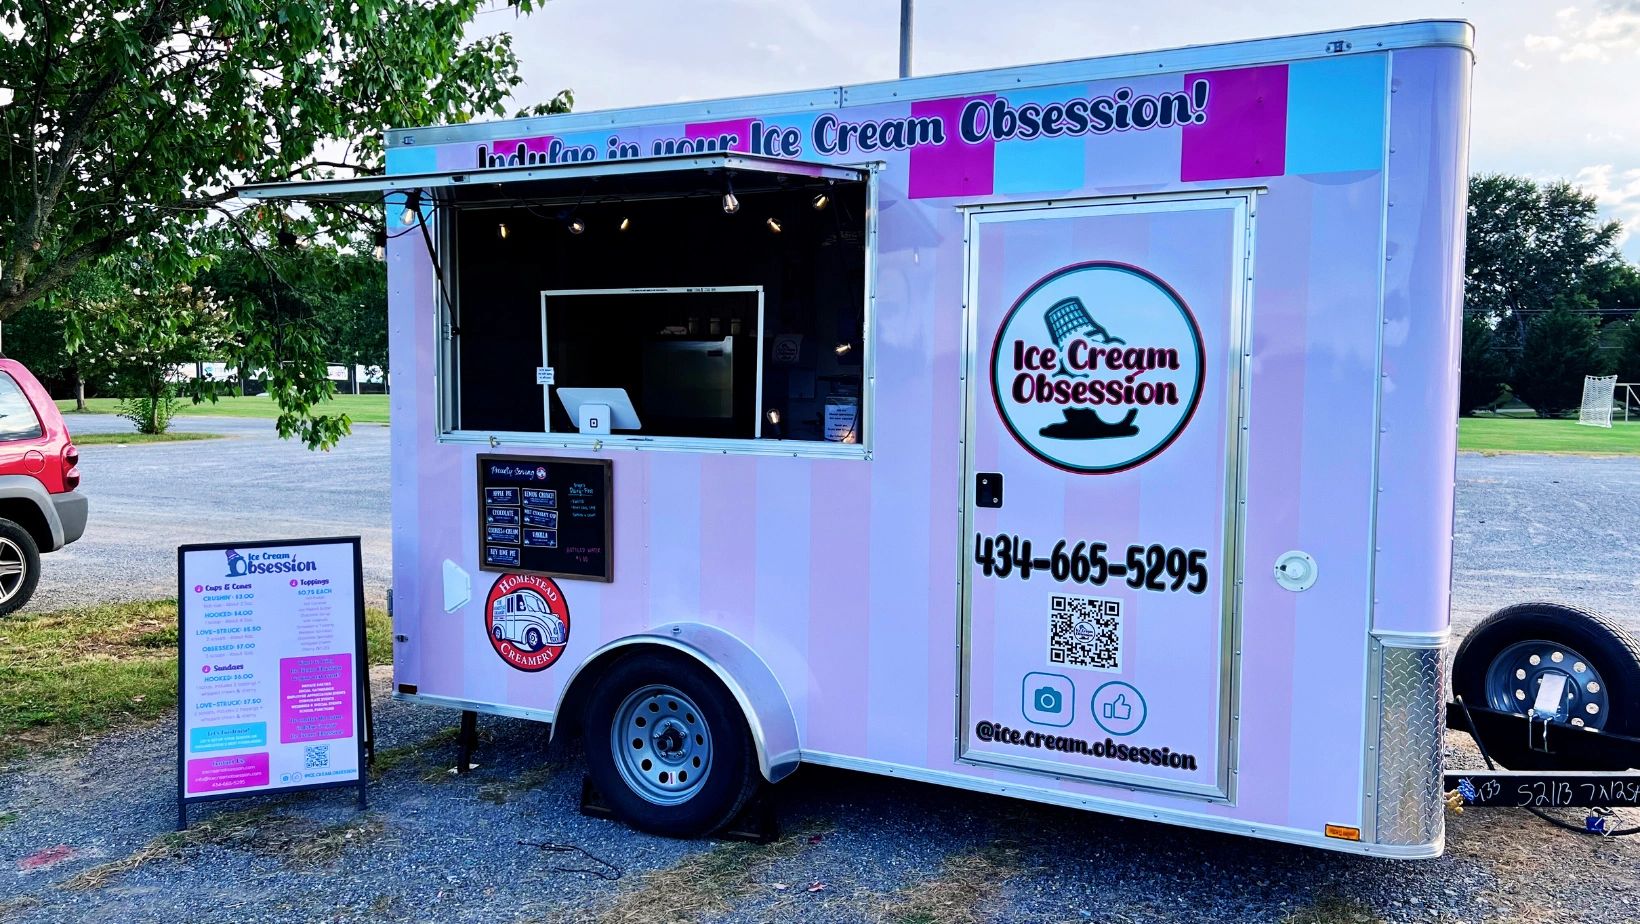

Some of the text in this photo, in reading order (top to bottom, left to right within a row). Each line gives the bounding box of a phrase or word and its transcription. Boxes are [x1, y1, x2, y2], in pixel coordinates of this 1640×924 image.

[607, 136, 640, 160] in
[750, 121, 801, 158] Ice
[813, 113, 945, 154] Cream
[960, 79, 1210, 145] Obsession!
[1013, 338, 1181, 371] Ice Cream
[1011, 372, 1180, 406] Obsession
[248, 552, 290, 560] Ice Cream
[975, 532, 1209, 595] 434-665-5295
[300, 578, 330, 586] Toppings
[499, 575, 558, 602] HOMESTEAD
[213, 664, 244, 672] Sundaes
[500, 642, 554, 666] CREAMERY
[976, 720, 1198, 771] @ice.cream.obsession
